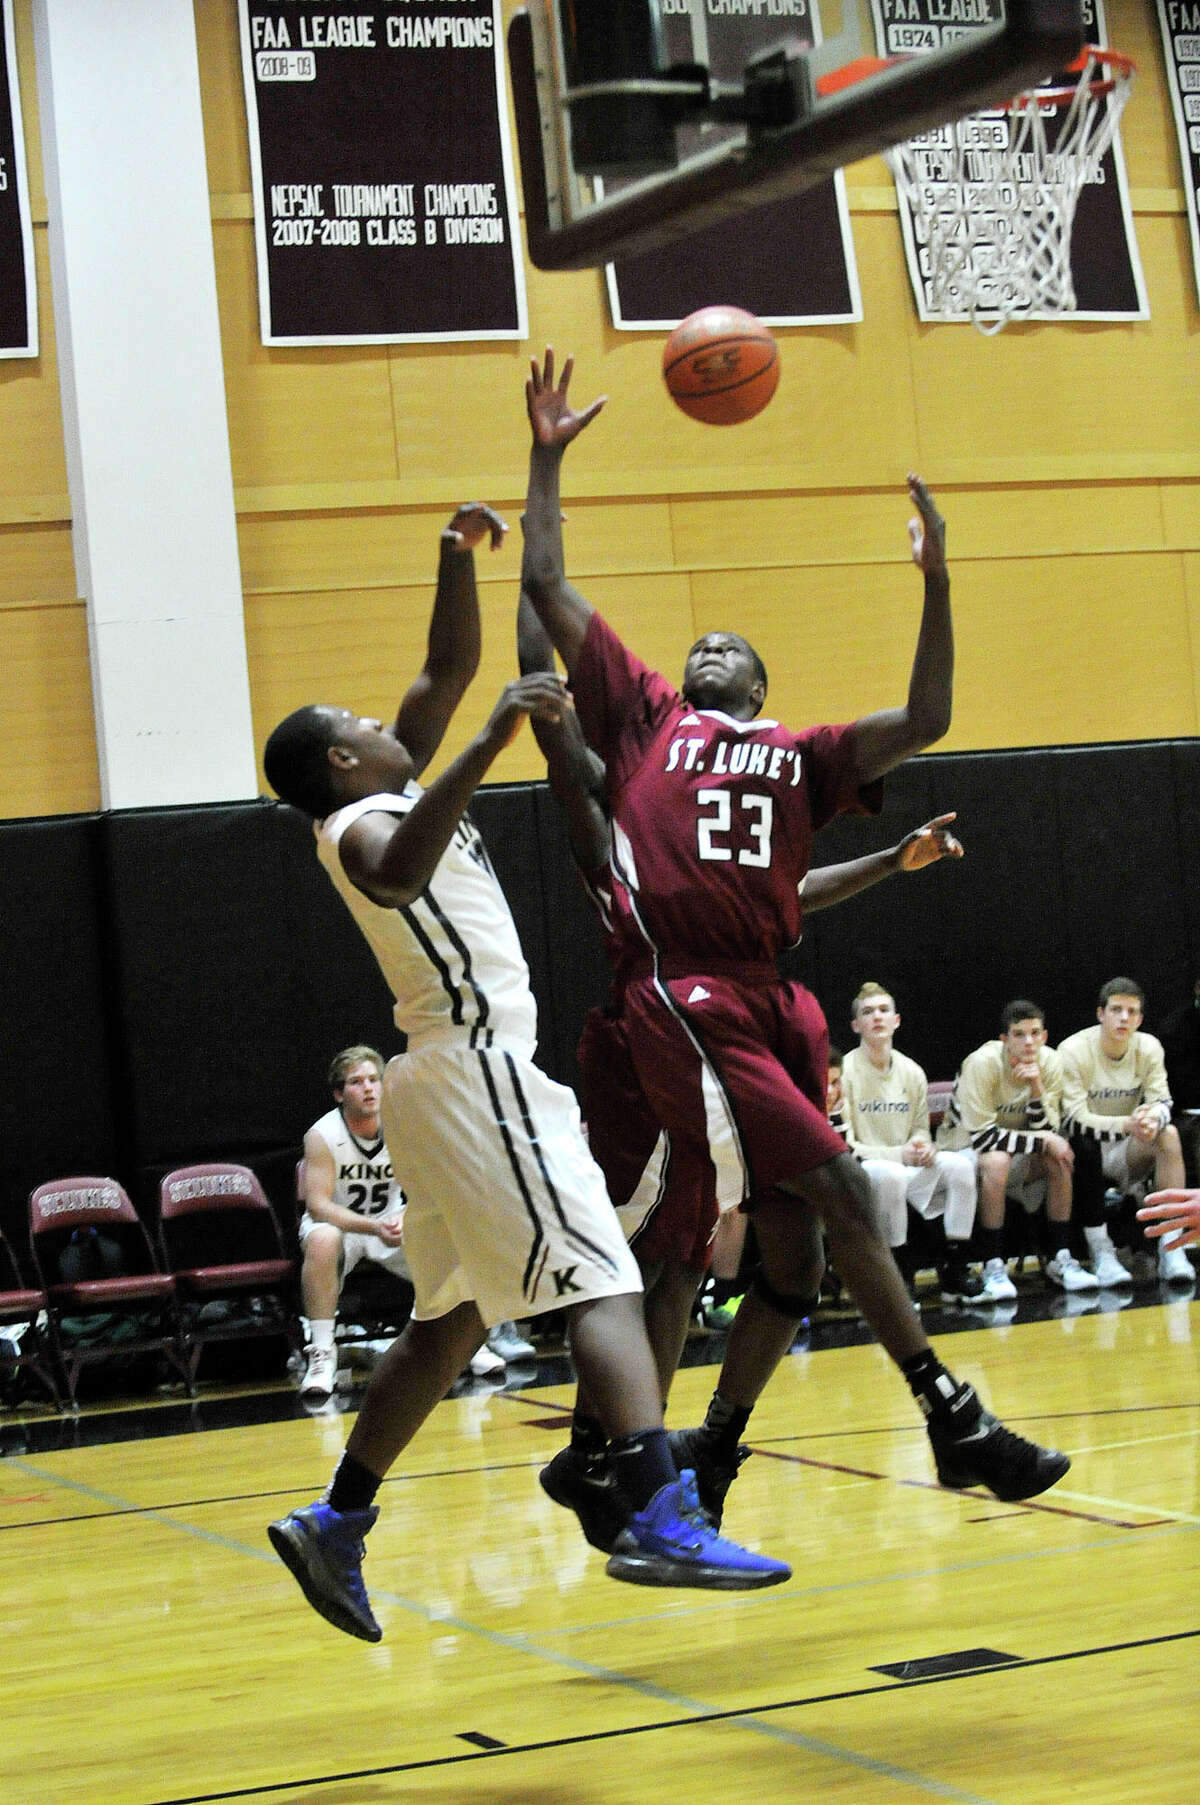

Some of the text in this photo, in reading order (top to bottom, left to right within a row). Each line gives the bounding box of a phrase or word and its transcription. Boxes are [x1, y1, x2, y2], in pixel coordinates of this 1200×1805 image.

[252, 16, 494, 49] FAA LEAGUE CHAMPIONS
[260, 57, 312, 76] 2008-09
[271, 183, 498, 217] NEPSAC TOURNAMENT CHAMPIONS
[272, 217, 504, 246] 2007-2008 CLASS B DIVISION
[665, 738, 801, 787] ST. LUKE'S
[697, 788, 773, 868] 23
[346, 1183, 390, 1215] 25
[552, 1264, 585, 1298] K
